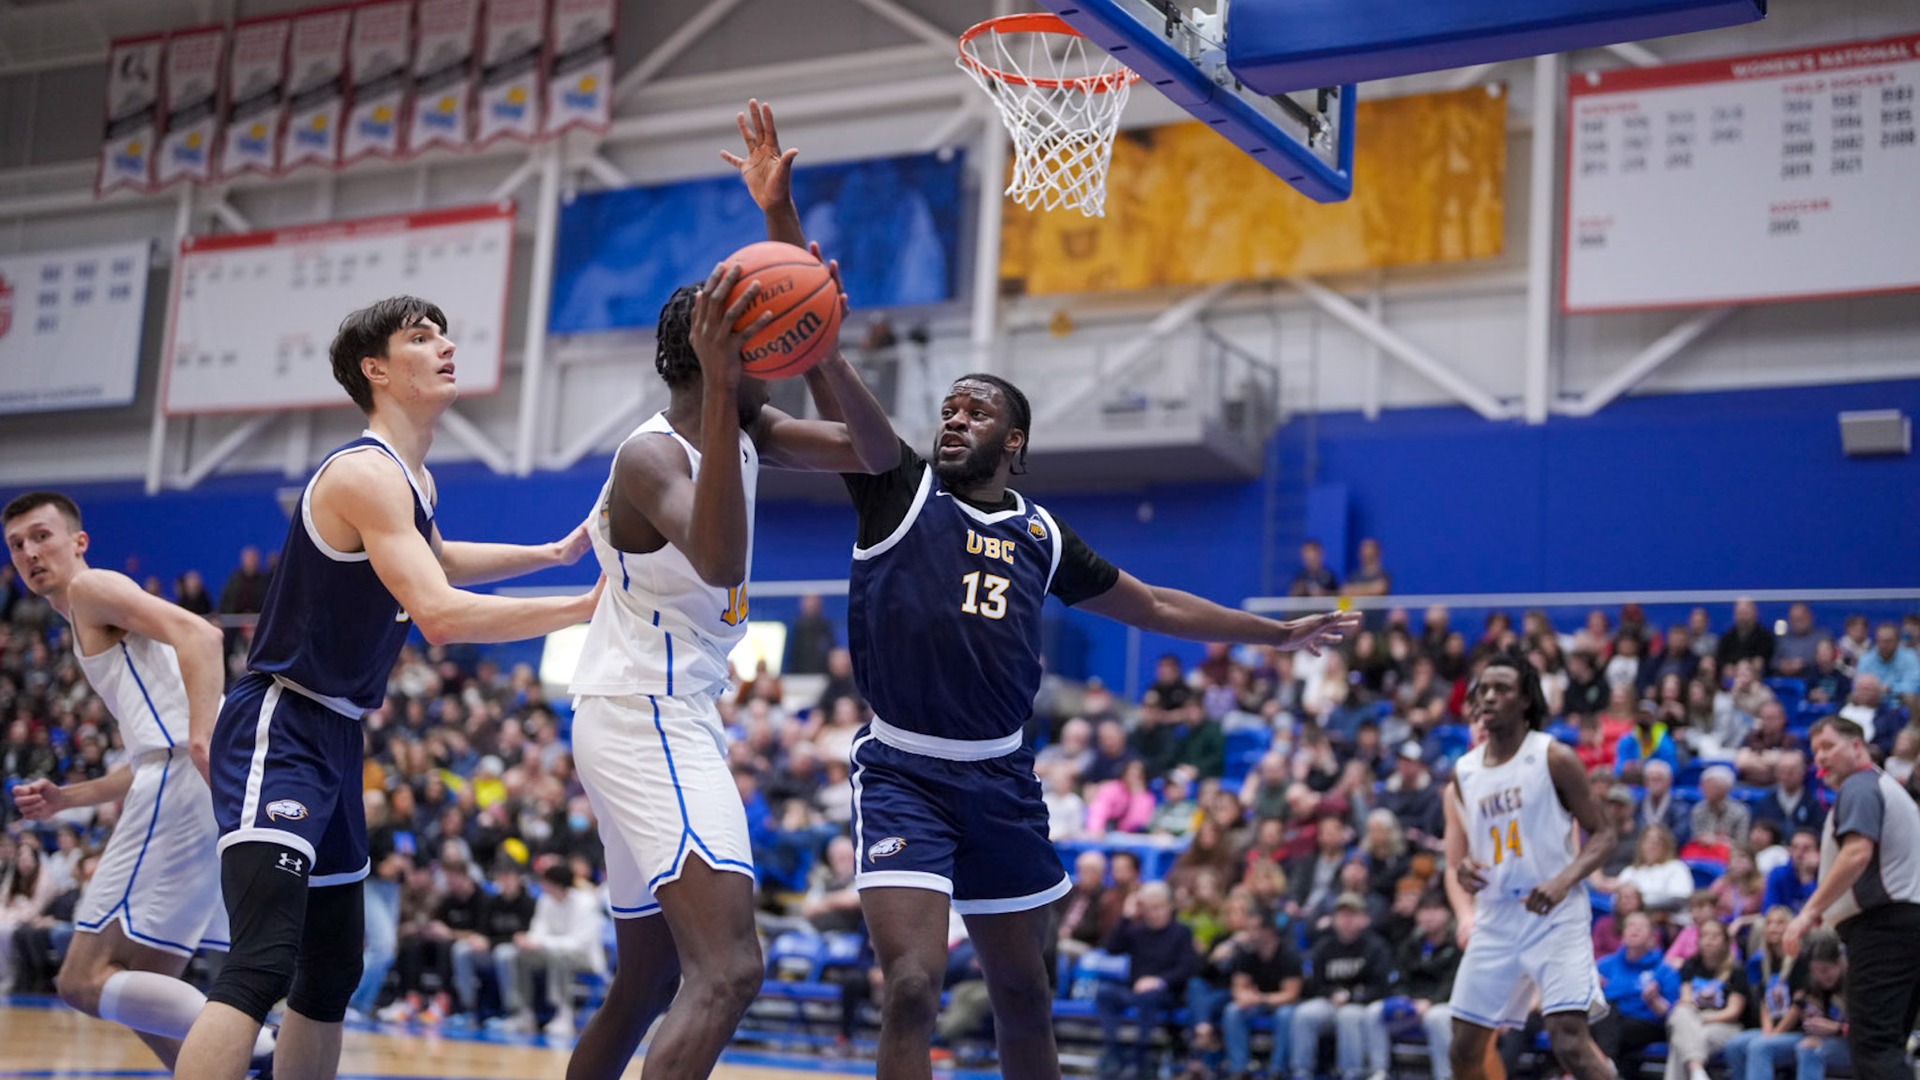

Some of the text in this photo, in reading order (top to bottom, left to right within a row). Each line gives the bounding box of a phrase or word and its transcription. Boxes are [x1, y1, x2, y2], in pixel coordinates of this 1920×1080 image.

[1818, 44, 1909, 67] NATIONAL
[741, 310, 822, 363] Wilson
[966, 529, 1016, 565] UBC
[961, 570, 1011, 621] 13
[1478, 786, 1523, 818] VIKES
[1490, 819, 1524, 864] 14
